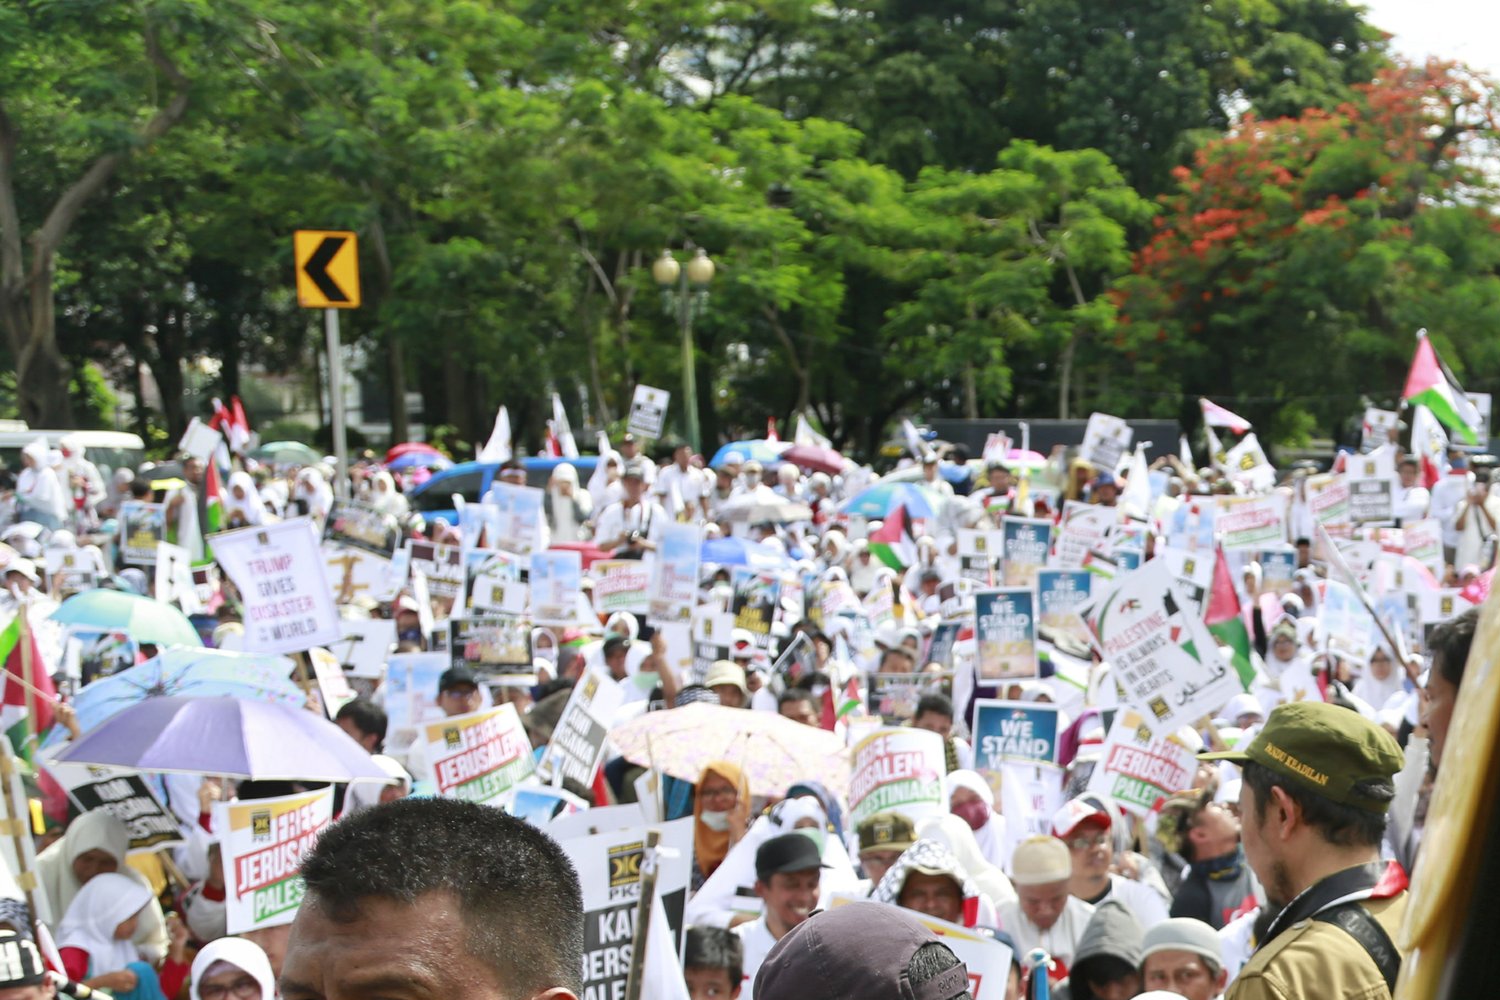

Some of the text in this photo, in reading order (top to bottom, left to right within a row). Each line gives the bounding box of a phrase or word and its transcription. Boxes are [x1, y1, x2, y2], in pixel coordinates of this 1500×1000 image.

[248, 553, 294, 577] TRUMP
[1104, 610, 1166, 655] PALESTINE
[1127, 633, 1166, 662] ALWAYS
[1134, 669, 1174, 698] HEARTS
[1000, 719, 1033, 738] WE
[981, 735, 1049, 757] STAND
[1285, 756, 1329, 786] KEADILAN
